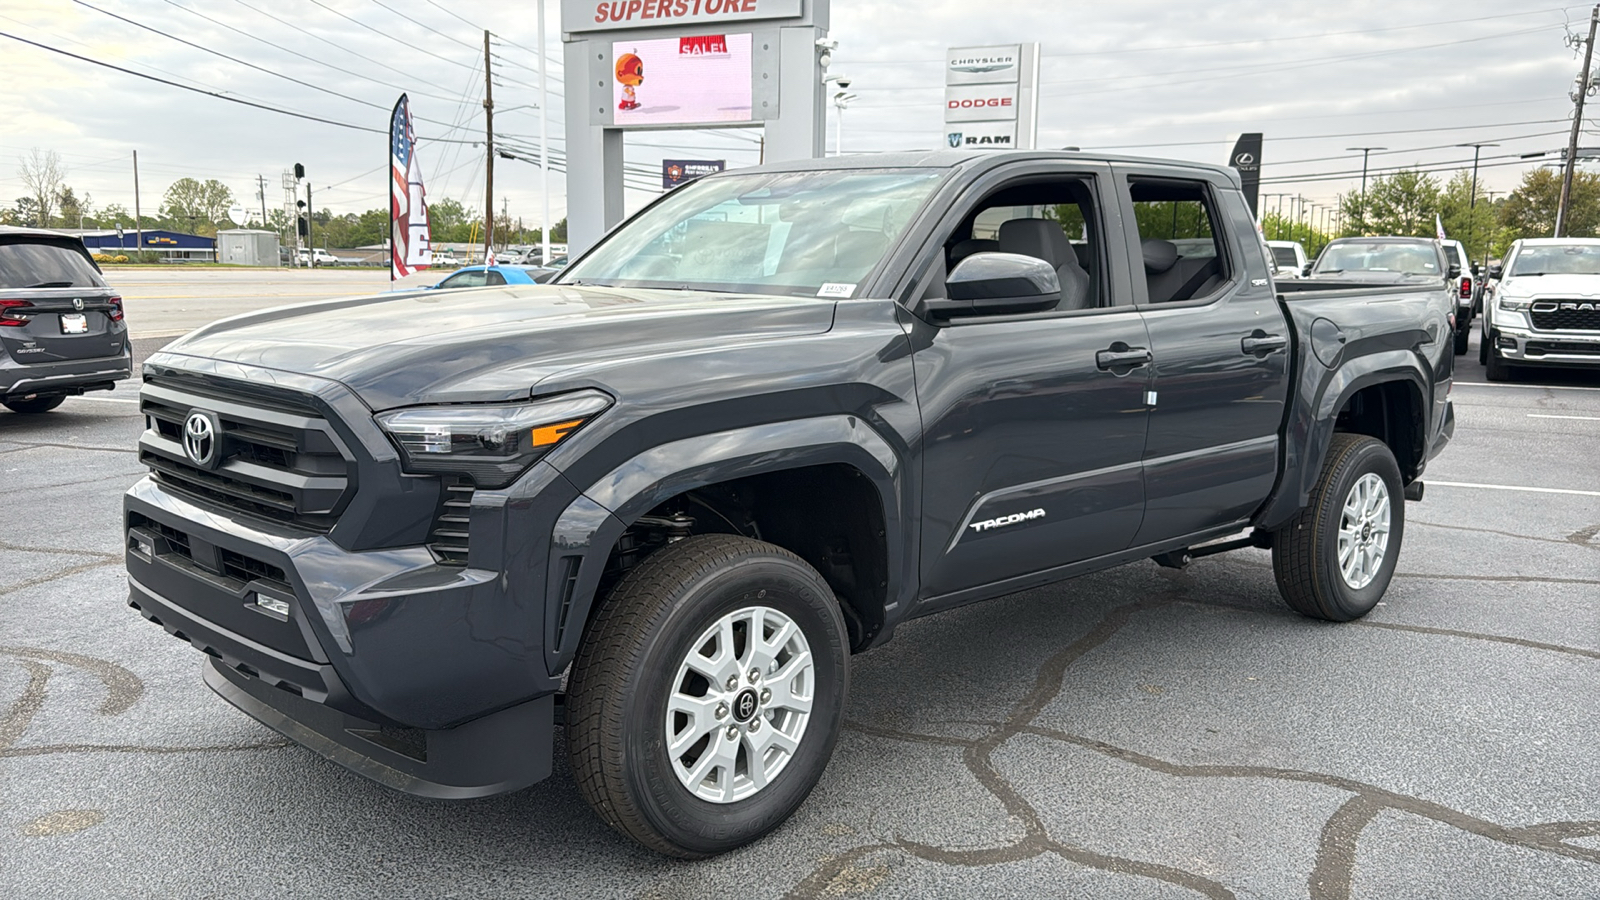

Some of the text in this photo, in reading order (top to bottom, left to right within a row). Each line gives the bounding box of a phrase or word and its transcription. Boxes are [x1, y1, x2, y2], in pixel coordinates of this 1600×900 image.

[595, 0, 757, 23] SUPERSTORE
[682, 43, 724, 54] SALE!
[951, 57, 1012, 65] CHRYSLER
[948, 98, 1012, 109] DODGE
[965, 136, 1010, 144] RAM
[1560, 303, 1600, 311] RA
[969, 508, 1046, 532] TACOMA
